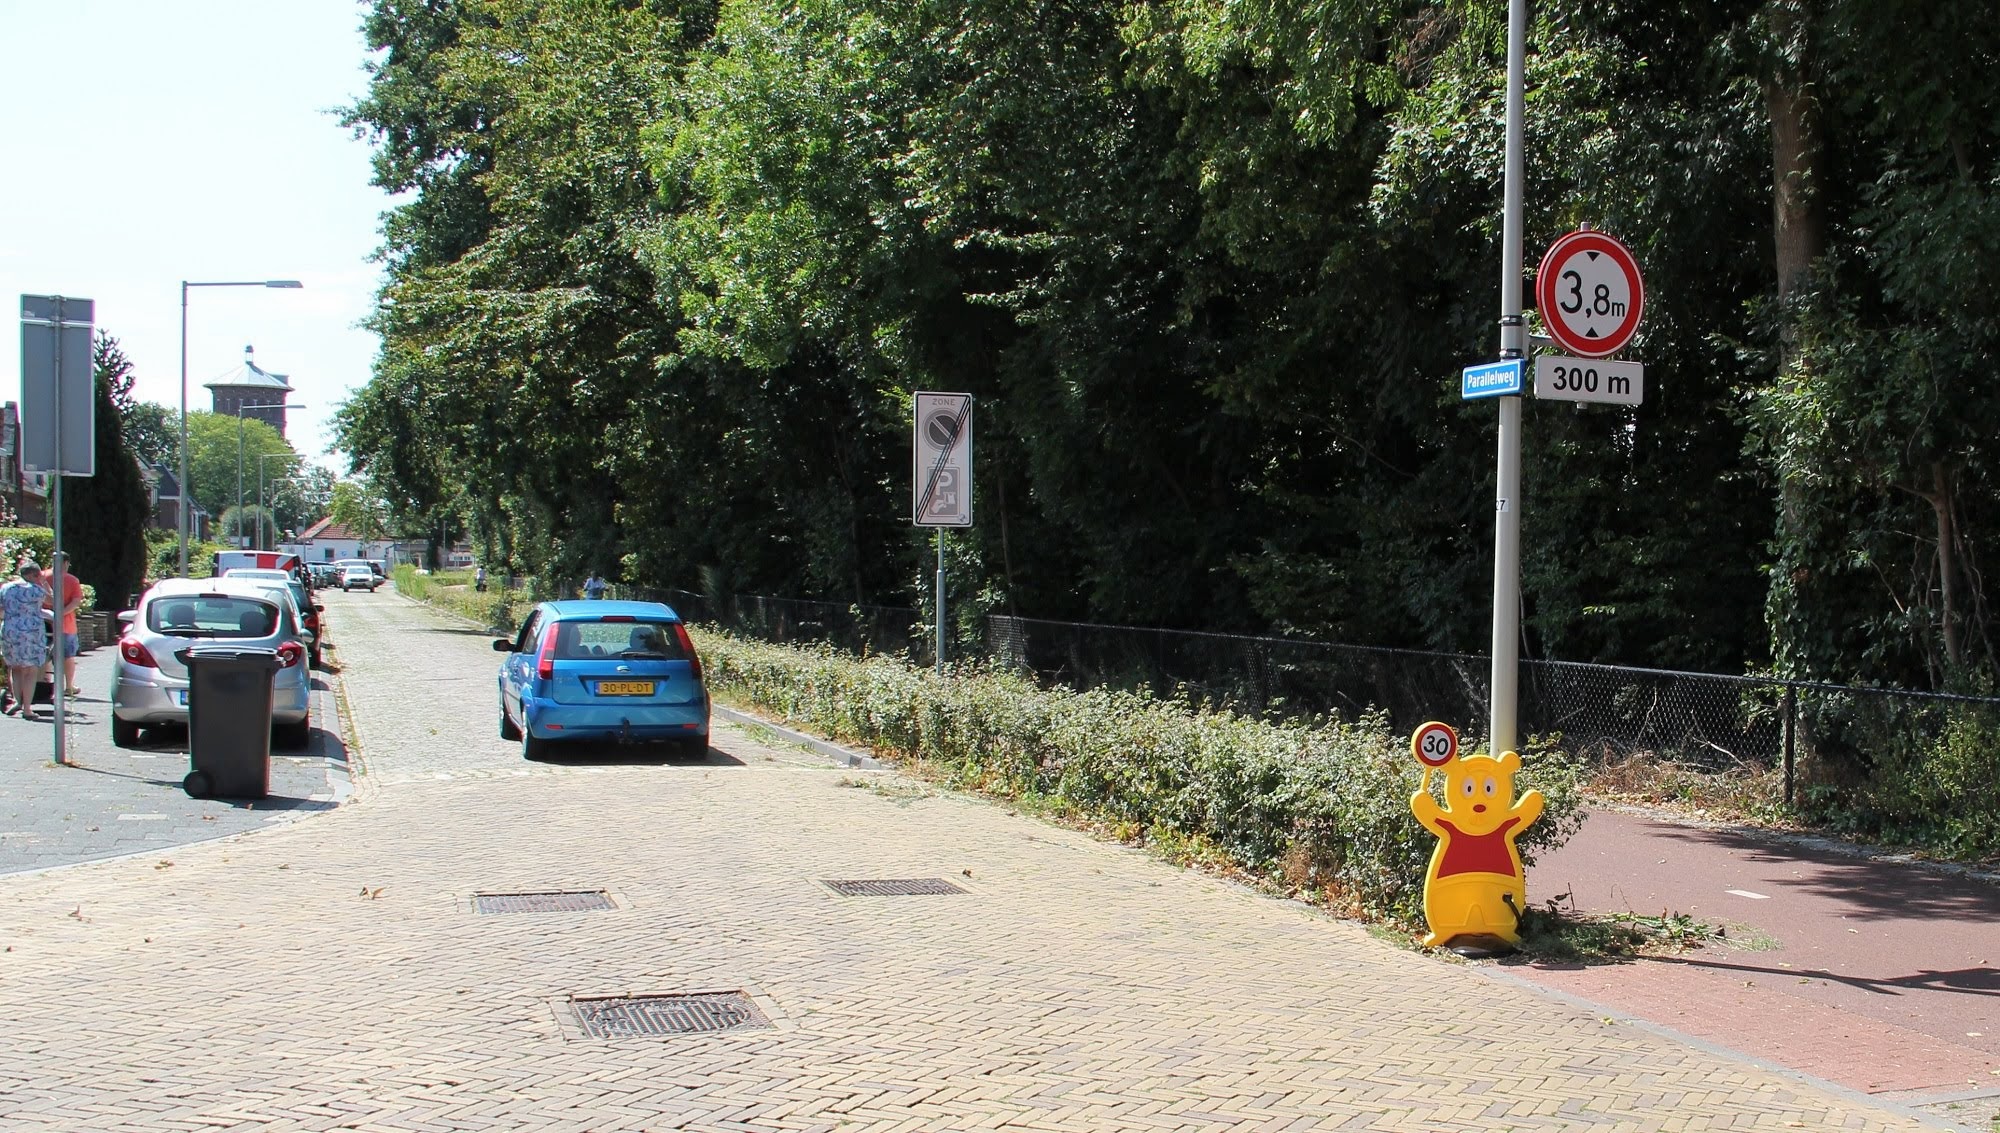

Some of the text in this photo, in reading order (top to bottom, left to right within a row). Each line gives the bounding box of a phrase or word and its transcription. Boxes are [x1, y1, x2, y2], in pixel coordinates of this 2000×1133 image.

[1467, 370, 1514, 389] Parallelweg
[1553, 366, 1630, 394] 300 m
[603, 683, 650, 692] 30-PL-DT
[1423, 735, 1448, 755] 30
